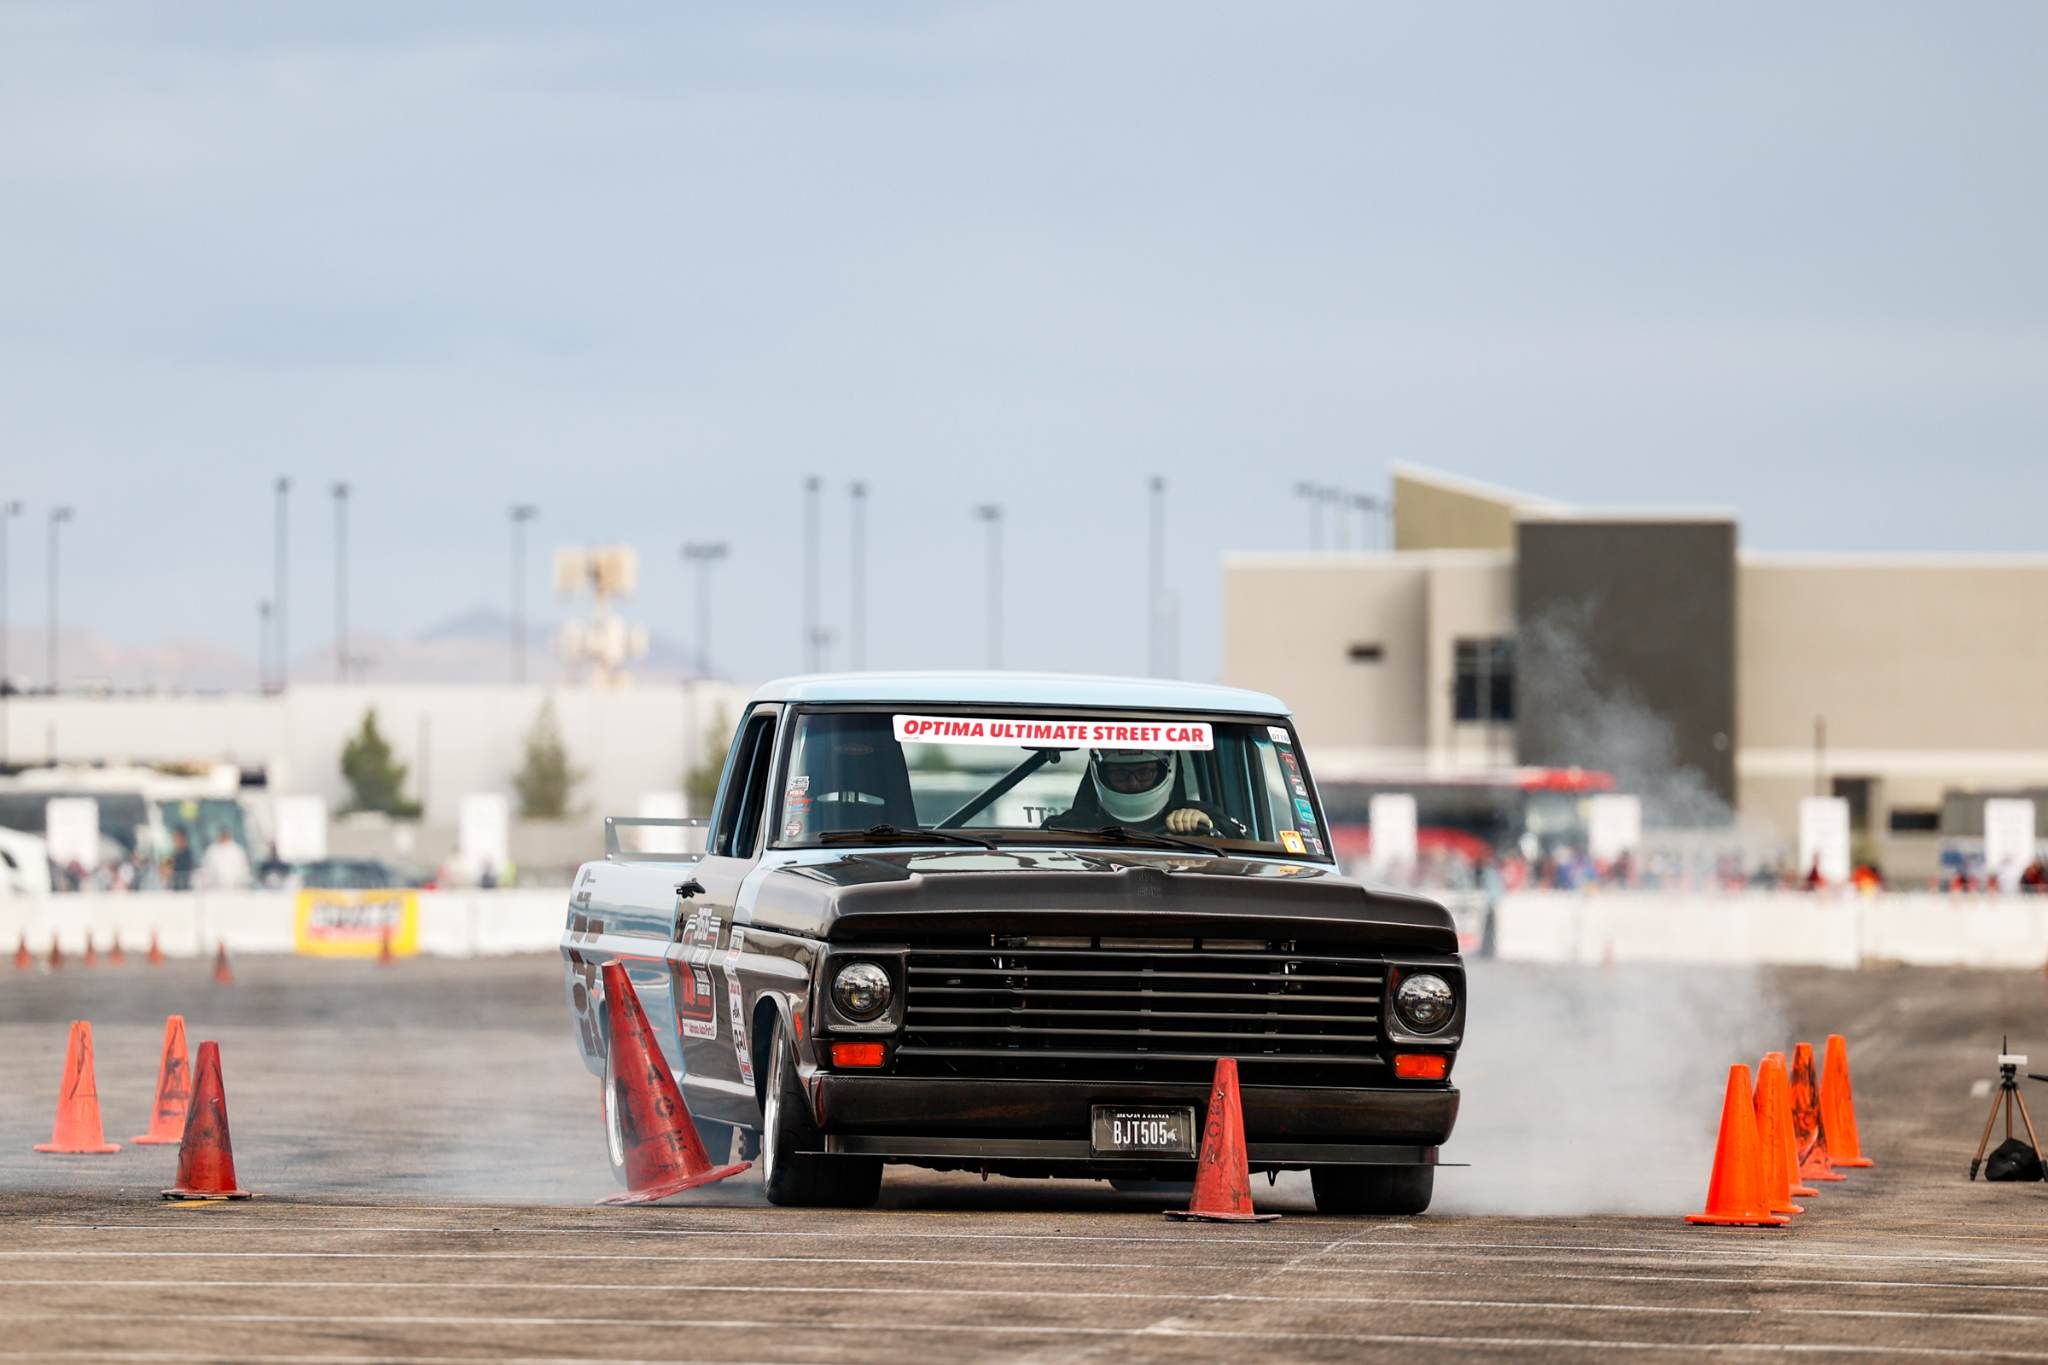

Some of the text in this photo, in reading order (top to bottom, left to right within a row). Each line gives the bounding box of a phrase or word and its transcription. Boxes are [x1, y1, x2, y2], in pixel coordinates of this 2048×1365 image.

[903, 720, 1205, 742] OPTIMA ULTIMATE STREET CAR
[1113, 1120, 1167, 1145] BJT505
